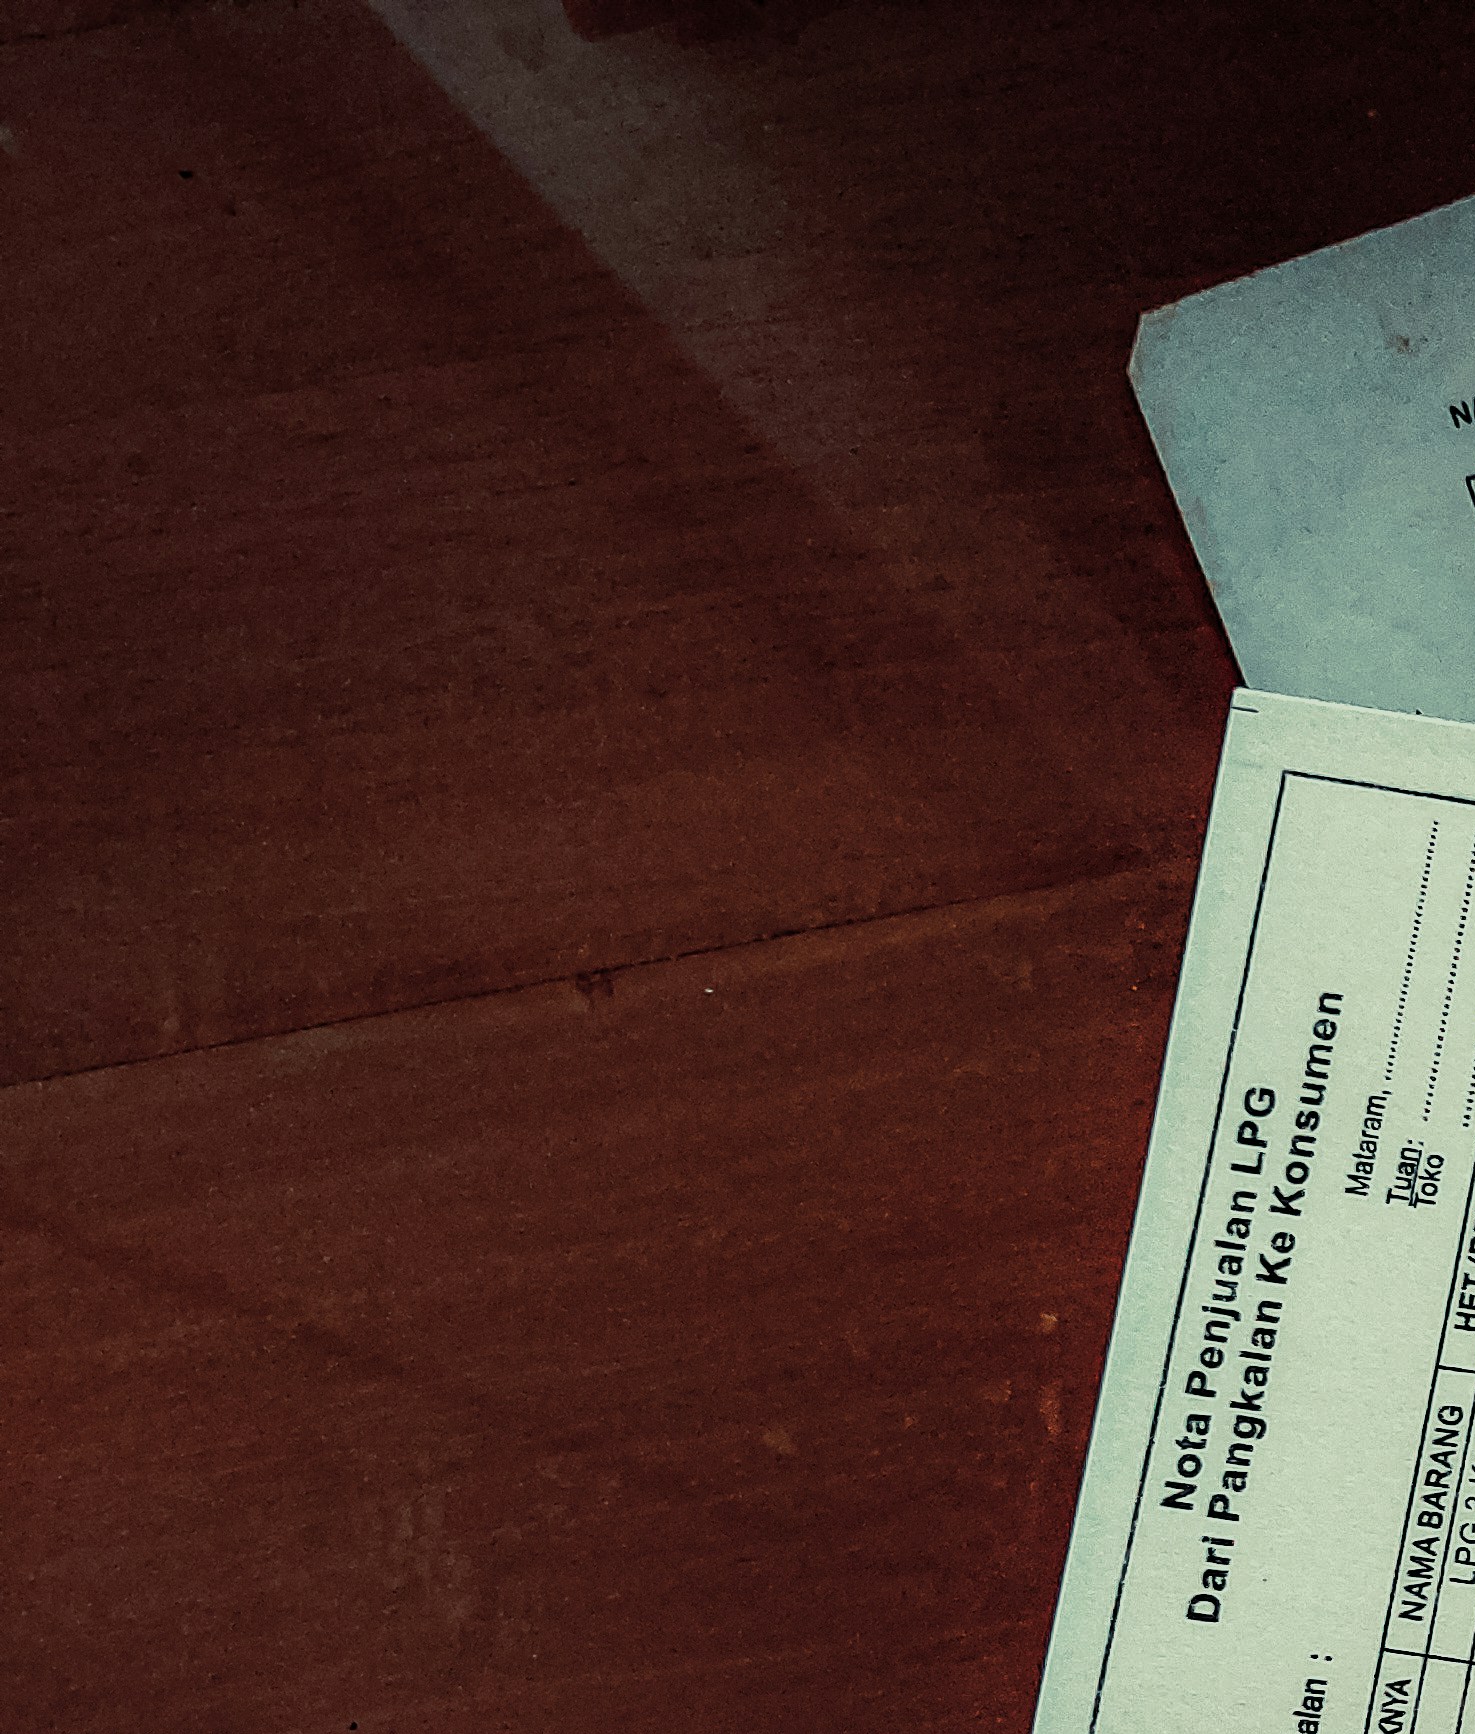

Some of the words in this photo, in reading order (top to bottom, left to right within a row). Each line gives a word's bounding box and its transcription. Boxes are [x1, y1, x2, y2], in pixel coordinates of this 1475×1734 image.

[1231, 1088, 1275, 1174] LPG
[1269, 993, 1343, 1216] Konsumen
[1345, 1091, 1391, 1196] Mataram,
[1414, 1155, 1444, 1208] Toko
[1185, 1191, 1257, 1397] Penjualan
[1256, 1232, 1295, 1284] Ke
[1207, 1301, 1282, 1521] Pangkalan
[1160, 1414, 1211, 1510] Nota
[1417, 1406, 1463, 1529] BARANG
[1186, 1536, 1234, 1622] Dari
[1398, 1537, 1440, 1621] NAMA
